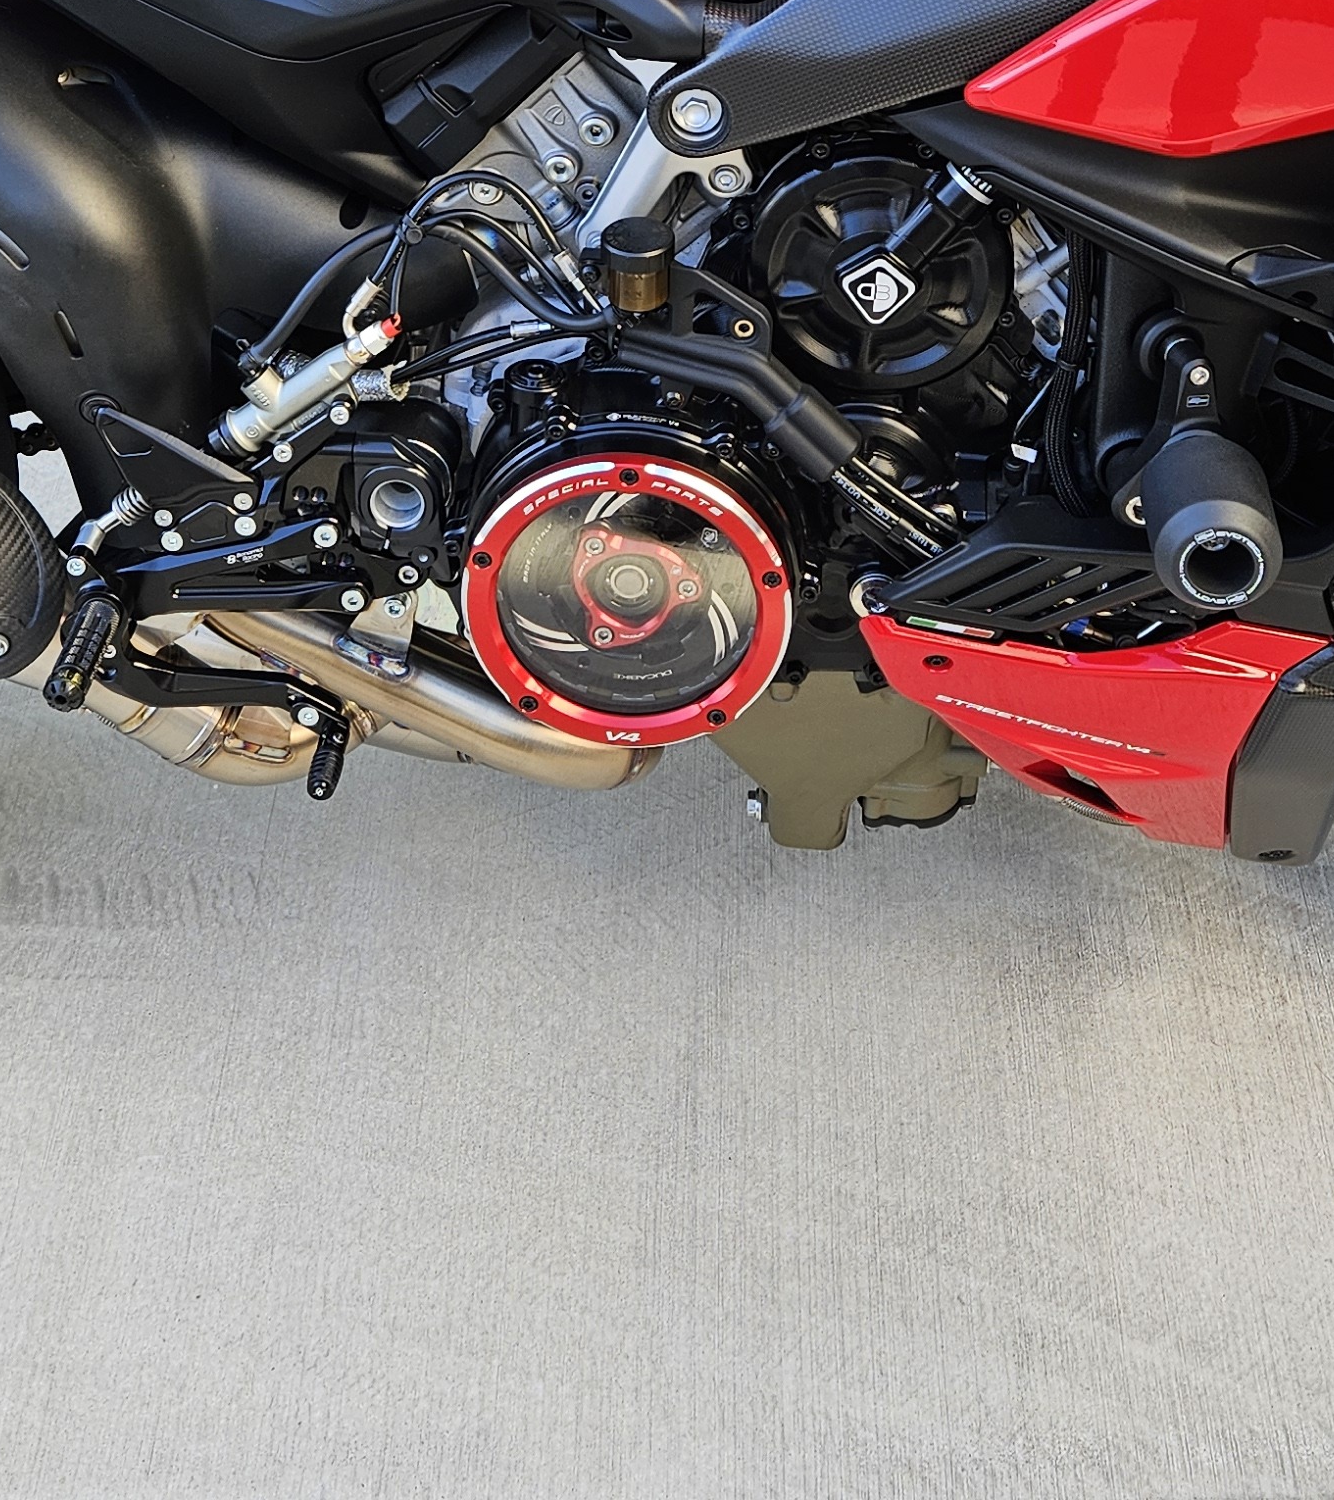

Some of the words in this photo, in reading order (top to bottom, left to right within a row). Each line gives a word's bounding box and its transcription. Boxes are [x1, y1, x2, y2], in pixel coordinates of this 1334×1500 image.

[523, 478, 609, 516] SPECIAL
[651, 481, 724, 517] PARTS
[606, 731, 641, 742] V4
[935, 694, 1124, 748] STREETFIGHTER
